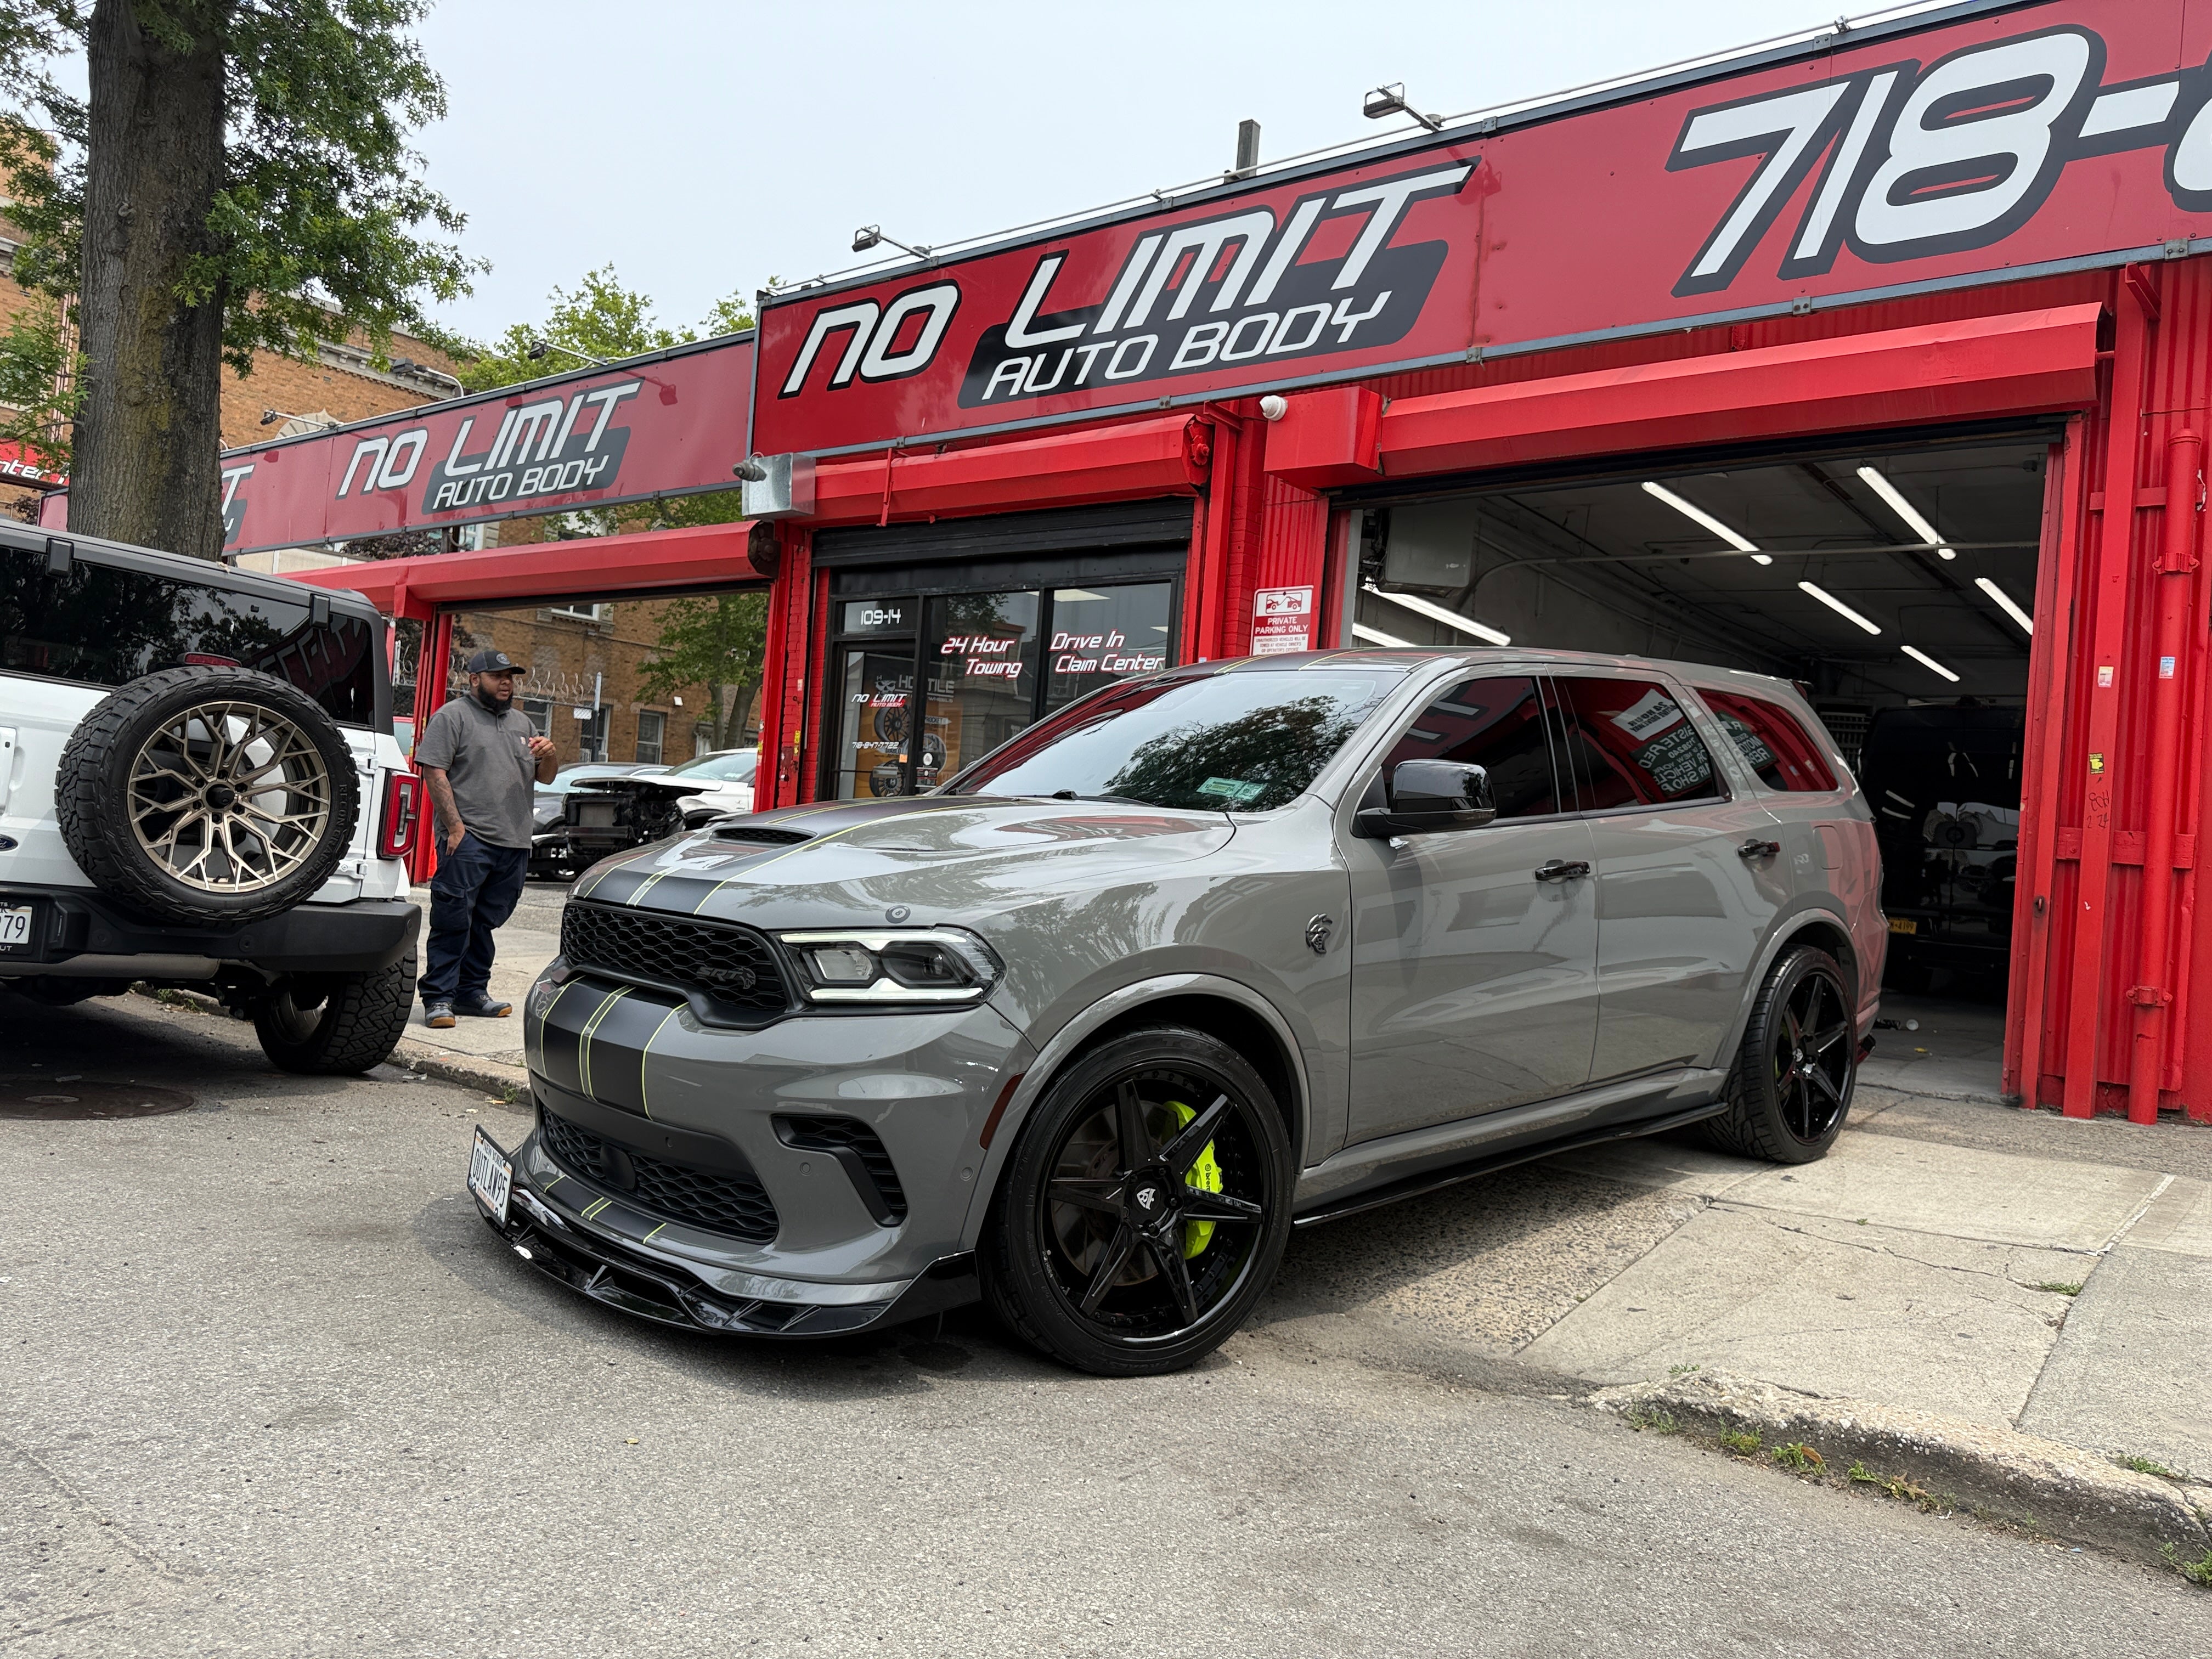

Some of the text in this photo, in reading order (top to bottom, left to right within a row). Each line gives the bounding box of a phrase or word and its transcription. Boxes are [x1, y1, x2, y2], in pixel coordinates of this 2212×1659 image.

[783, 164, 1474, 395] NO LIMIT
[981, 290, 1392, 401] AUTO BODY
[338, 430, 428, 498] NO
[444, 382, 641, 477] LIMIT
[432, 455, 610, 510] AUTO BODY
[861, 608, 901, 625] 109-14
[1267, 616, 1297, 625] PRIVATE
[1255, 624, 1308, 635] PARKING ONLY
[940, 636, 1015, 654] 24 Hour
[1049, 630, 1125, 650] Drive In
[966, 658, 1022, 678] Towing
[1054, 653, 1166, 673] Claim Center
[851, 693, 870, 703] NO
[873, 693, 908, 703] LIMIT
[0, 915, 26, 939] 79
[696, 966, 743, 981] SRT
[483, 1141, 504, 1170] NEW YORK
[472, 1148, 507, 1209] OUTLAW95
